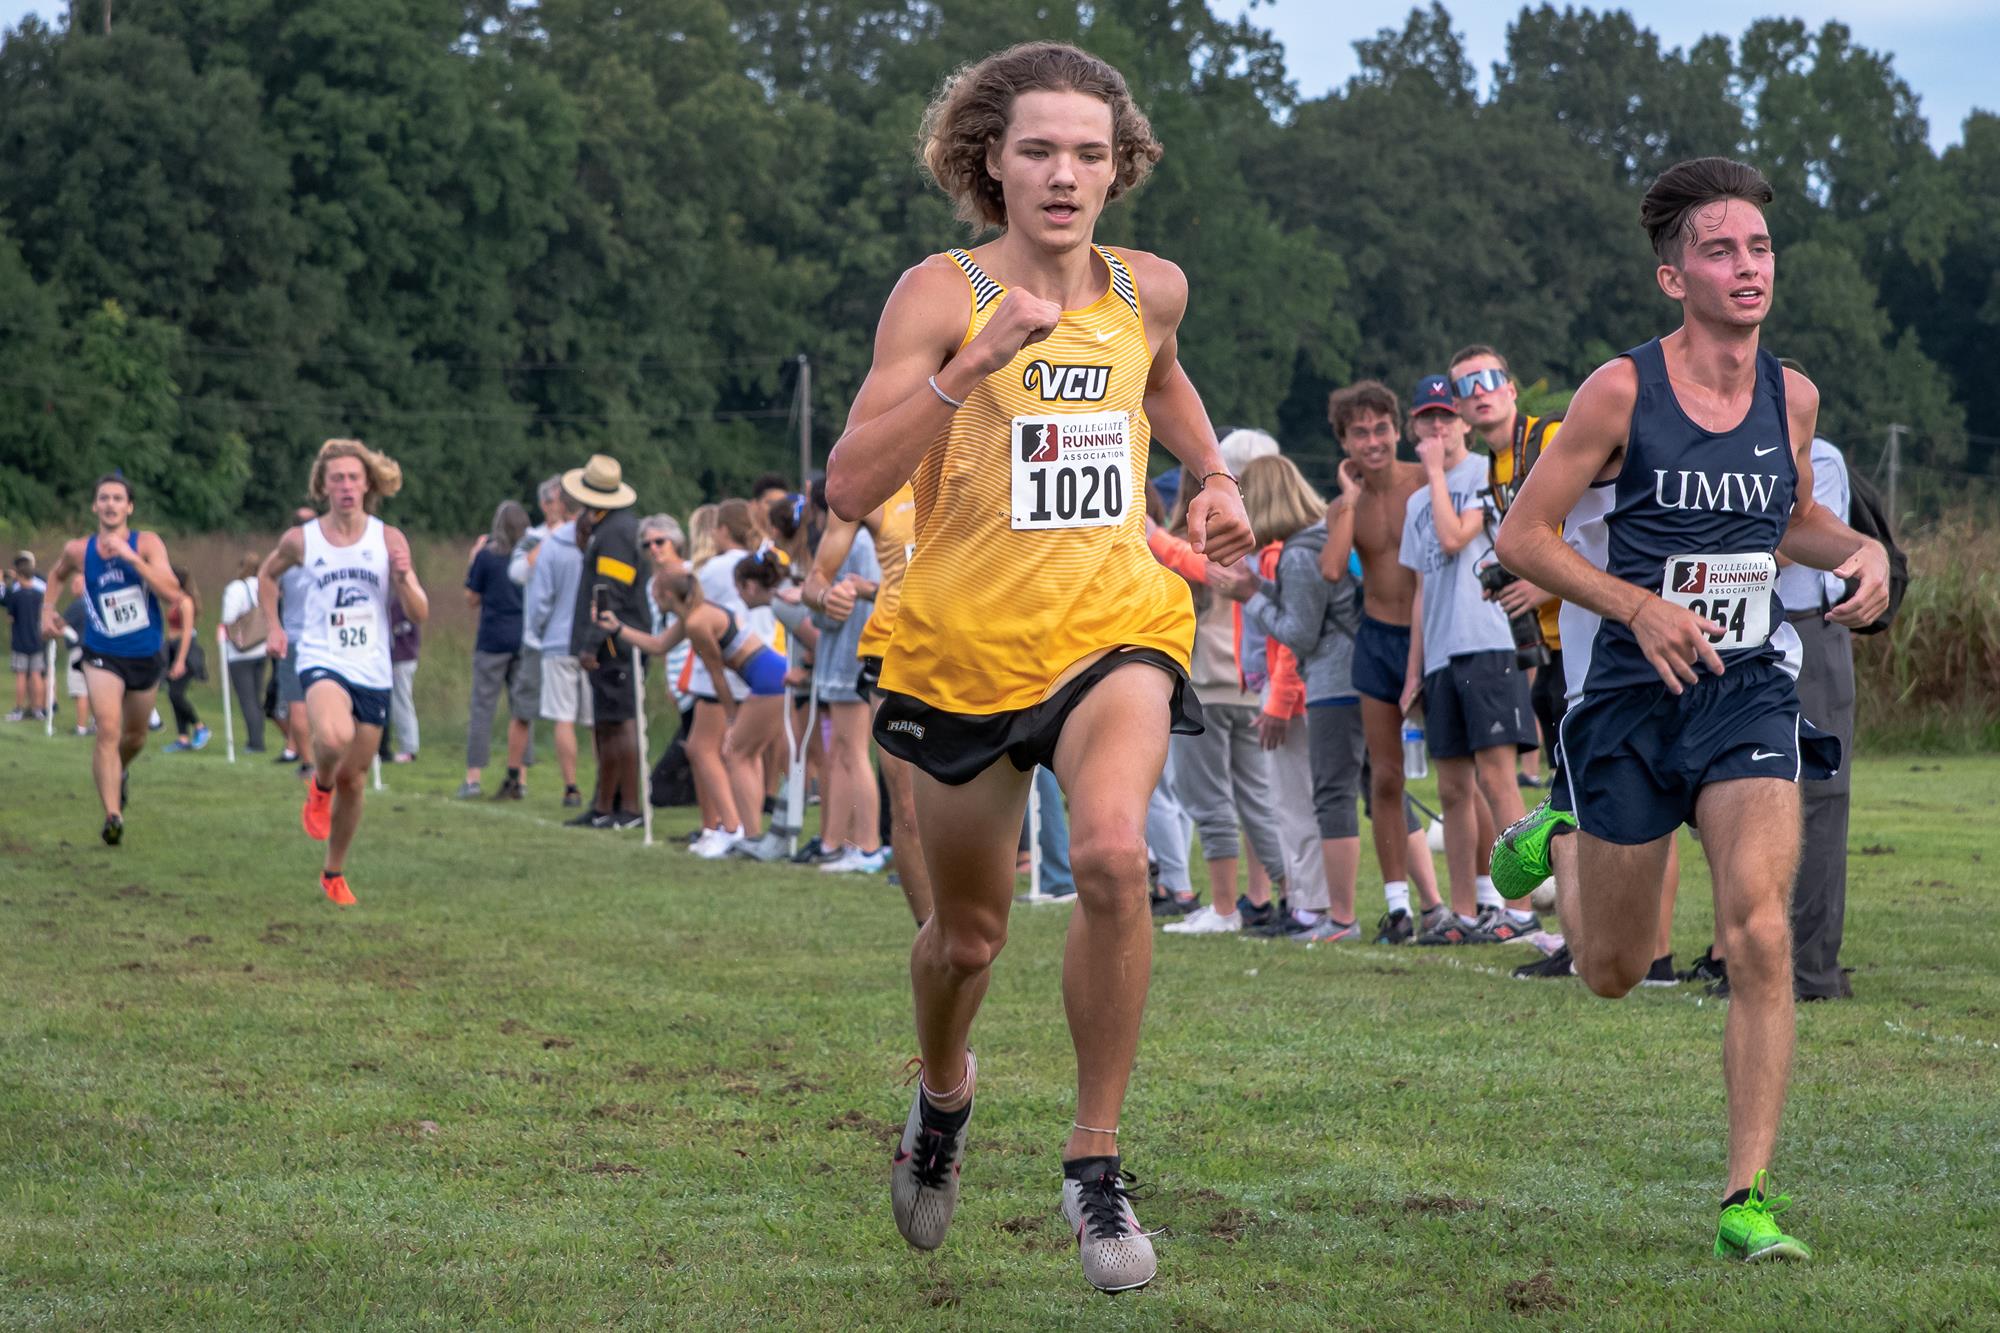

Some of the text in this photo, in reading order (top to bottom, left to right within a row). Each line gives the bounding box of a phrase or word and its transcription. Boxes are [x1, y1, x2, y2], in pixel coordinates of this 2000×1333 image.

[1023, 359, 1113, 401] VCU
[1063, 422, 1123, 433] COLLEGIATE
[1062, 432, 1123, 449] RUNNING
[1063, 451, 1124, 461] ASSOCIATION
[1030, 464, 1123, 522] 1020
[1654, 469, 1778, 512] UMW
[1711, 562, 1769, 572] COLLEGIATE
[1709, 571, 1768, 584] RUNNING
[1708, 585, 1766, 595] ASSOCIATION
[339, 626, 367, 647] 926
[887, 720, 926, 740] RAMS
